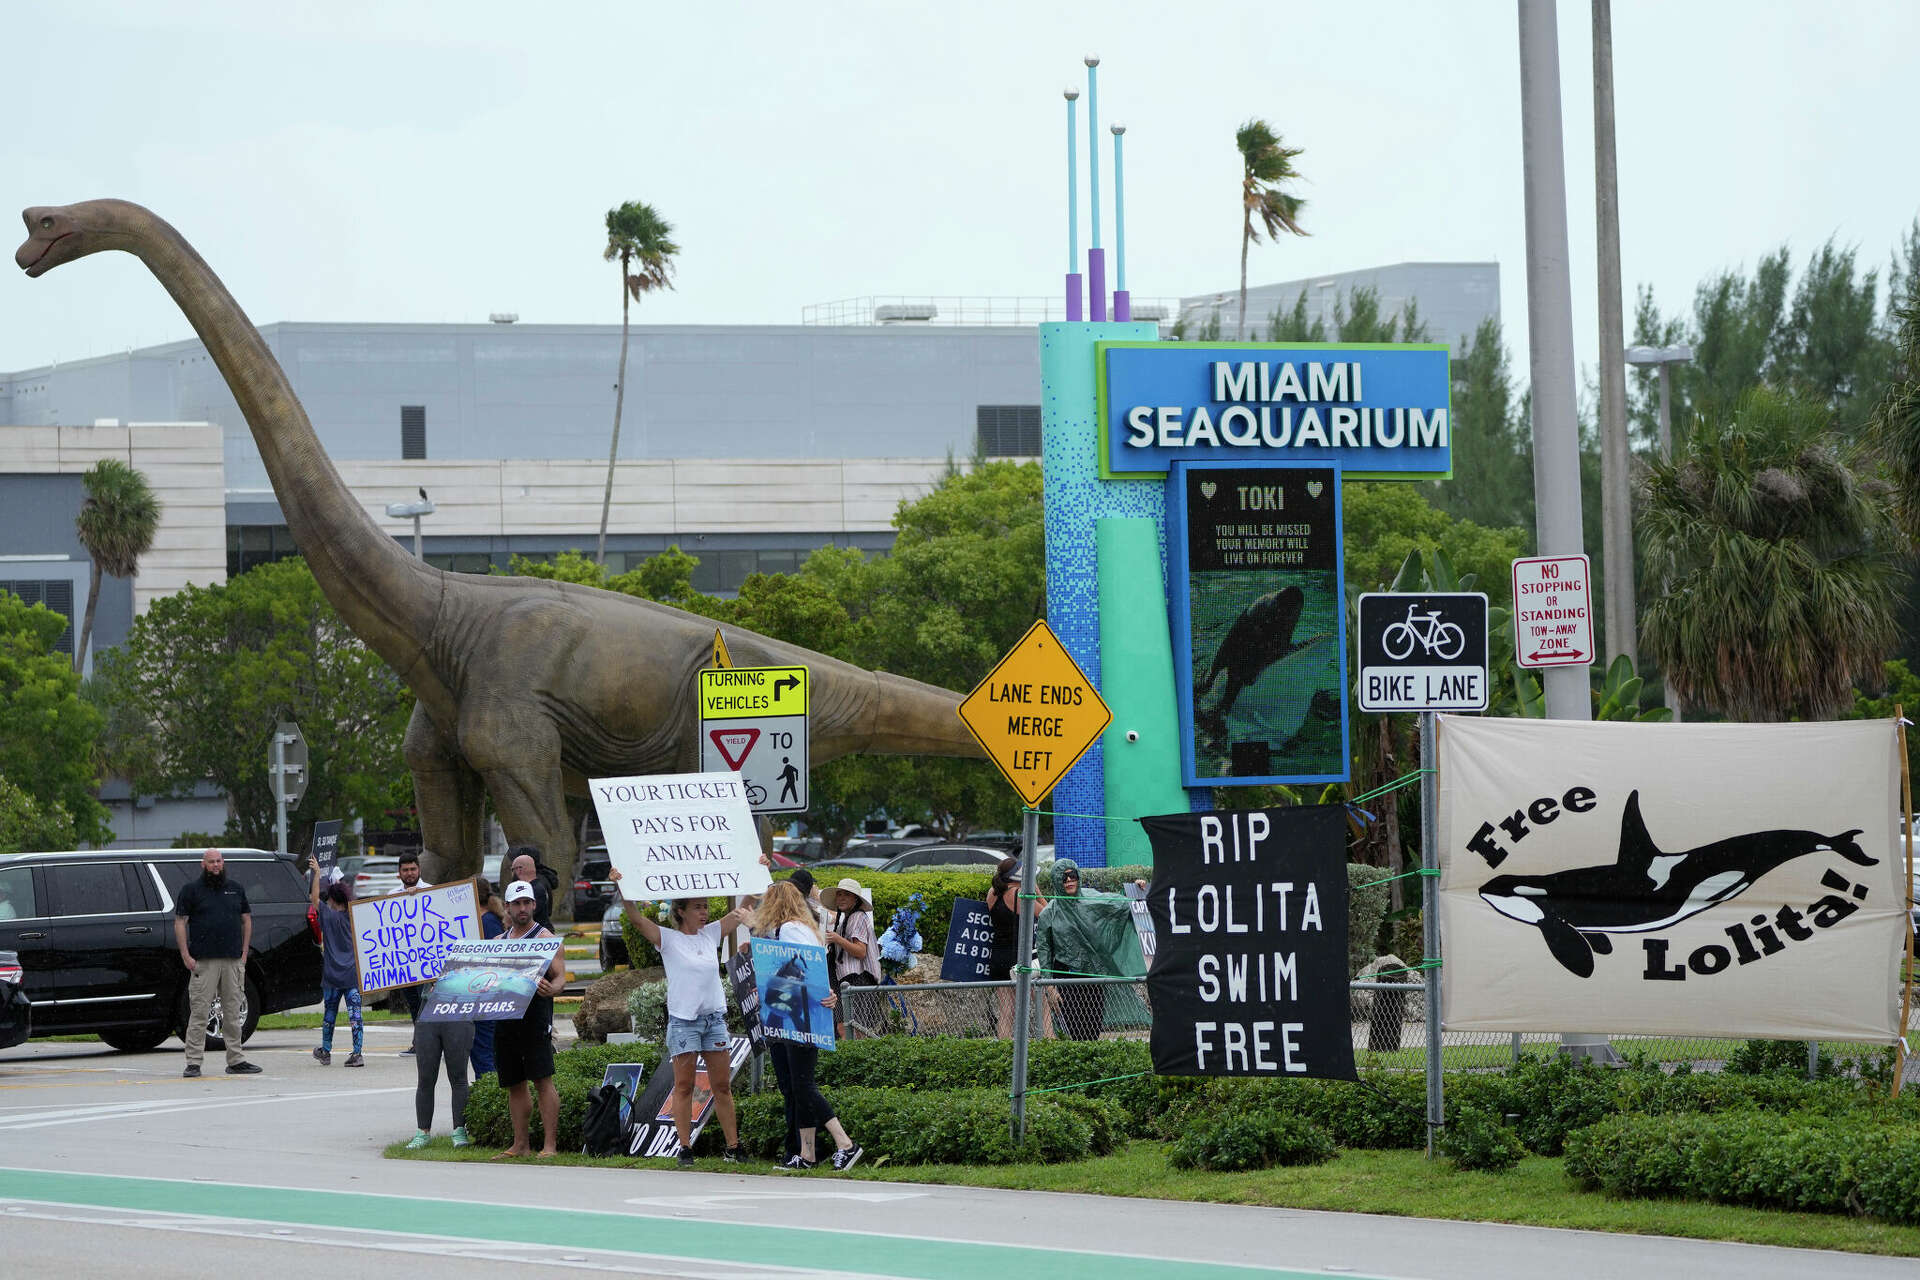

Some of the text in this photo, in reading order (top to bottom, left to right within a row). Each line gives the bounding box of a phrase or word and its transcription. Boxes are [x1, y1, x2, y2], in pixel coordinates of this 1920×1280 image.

[1213, 361, 1363, 402] MIAMI
[1126, 405, 1449, 448] SEAQUARIUM
[1237, 485, 1285, 511] TOKI
[1215, 524, 1311, 536] YOU WILL BE MISSED
[1216, 538, 1309, 550] YOUR MEMORY WILL
[1223, 552, 1304, 565] LIVE ON FOREVER
[1541, 563, 1559, 580] NO
[1521, 580, 1582, 595] STOPPING
[1546, 595, 1558, 607] OR
[1521, 607, 1586, 622] STANDING
[1530, 623, 1577, 637] TOW-AWAY
[1539, 637, 1571, 650] ZONE
[707, 672, 765, 687] TURNING
[1369, 675, 1479, 701] BIKE LANE
[707, 695, 769, 710] VEHICLES
[989, 683, 1083, 706] LANE ENDS
[1008, 716, 1064, 737] MERGE
[725, 737, 746, 745] YIELD
[769, 732, 793, 750] TO
[1013, 750, 1053, 771] LEFT
[600, 782, 738, 803] YOUR TICKET
[631, 815, 731, 834] PAYS FOR
[1466, 786, 1597, 870] Free
[1200, 812, 1270, 864] RIP
[646, 844, 731, 862] ANIMAL
[645, 872, 740, 892] CRUELTY
[373, 894, 446, 927] YOUR
[1131, 900, 1149, 913] CAPT
[1169, 882, 1323, 934] LOLITA
[961, 927, 970, 940] A
[1642, 868, 1870, 981] Lolita!
[362, 915, 470, 954] SUPPORT
[452, 941, 560, 954] BEGGING FOR FOOD
[755, 943, 824, 962] CAPTIVITY IS A
[954, 942, 968, 955] EL
[970, 945, 979, 957] 8
[363, 965, 418, 991] ANIMAL
[975, 962, 991, 976] DE
[1198, 951, 1298, 1003] SWIM
[433, 1001, 516, 1015] FOR 53 YEARS.
[763, 1025, 833, 1046] DEATH SENTENCE
[1195, 1021, 1307, 1072] FREE
